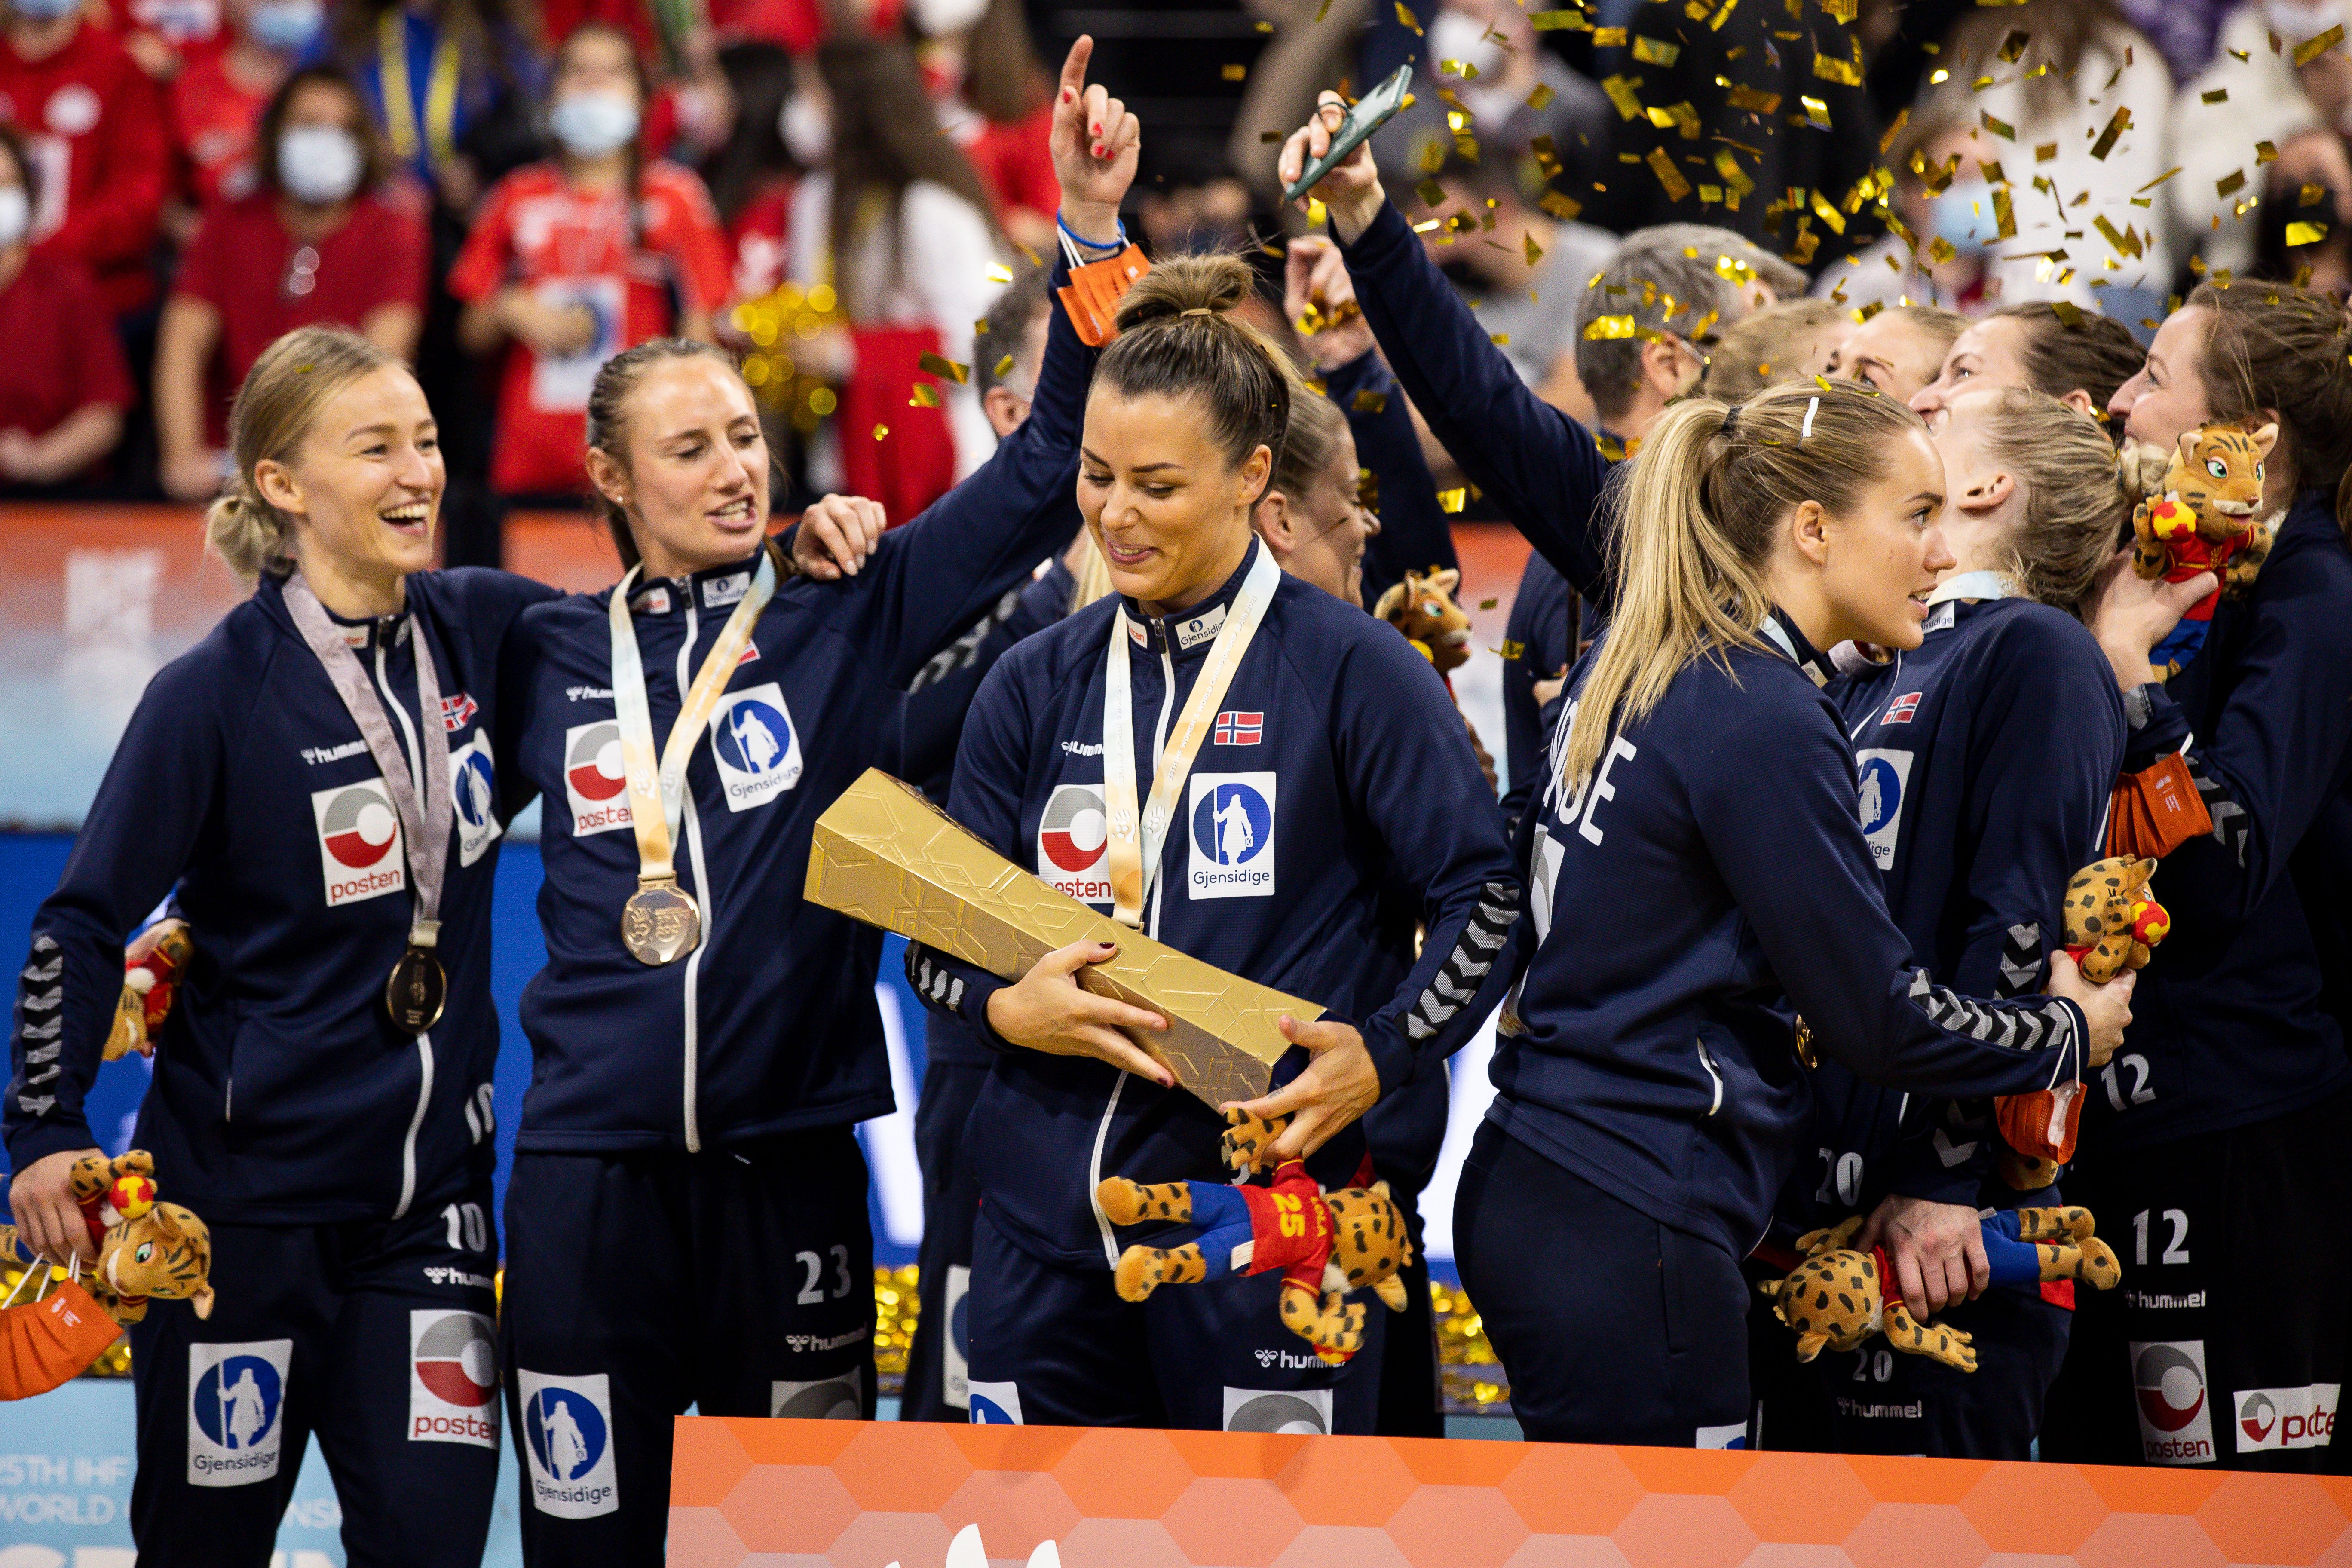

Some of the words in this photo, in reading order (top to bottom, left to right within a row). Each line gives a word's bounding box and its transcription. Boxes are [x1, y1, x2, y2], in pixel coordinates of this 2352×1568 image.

[330, 869, 401, 902] posten
[1193, 869, 1270, 888] Gjensidige
[2101, 1053, 2156, 1112] 12
[1816, 1148, 1864, 1207] 20
[440, 1202, 487, 1252] 10
[1271, 1192, 1306, 1238] 25
[2133, 1208, 2190, 1265] 12
[795, 1244, 852, 1305] 23
[2138, 1289, 2206, 1309] hummel
[1852, 1348, 1893, 1383] 20
[1852, 1398, 1922, 1418] hummel
[74, 1455, 129, 1485] IHF
